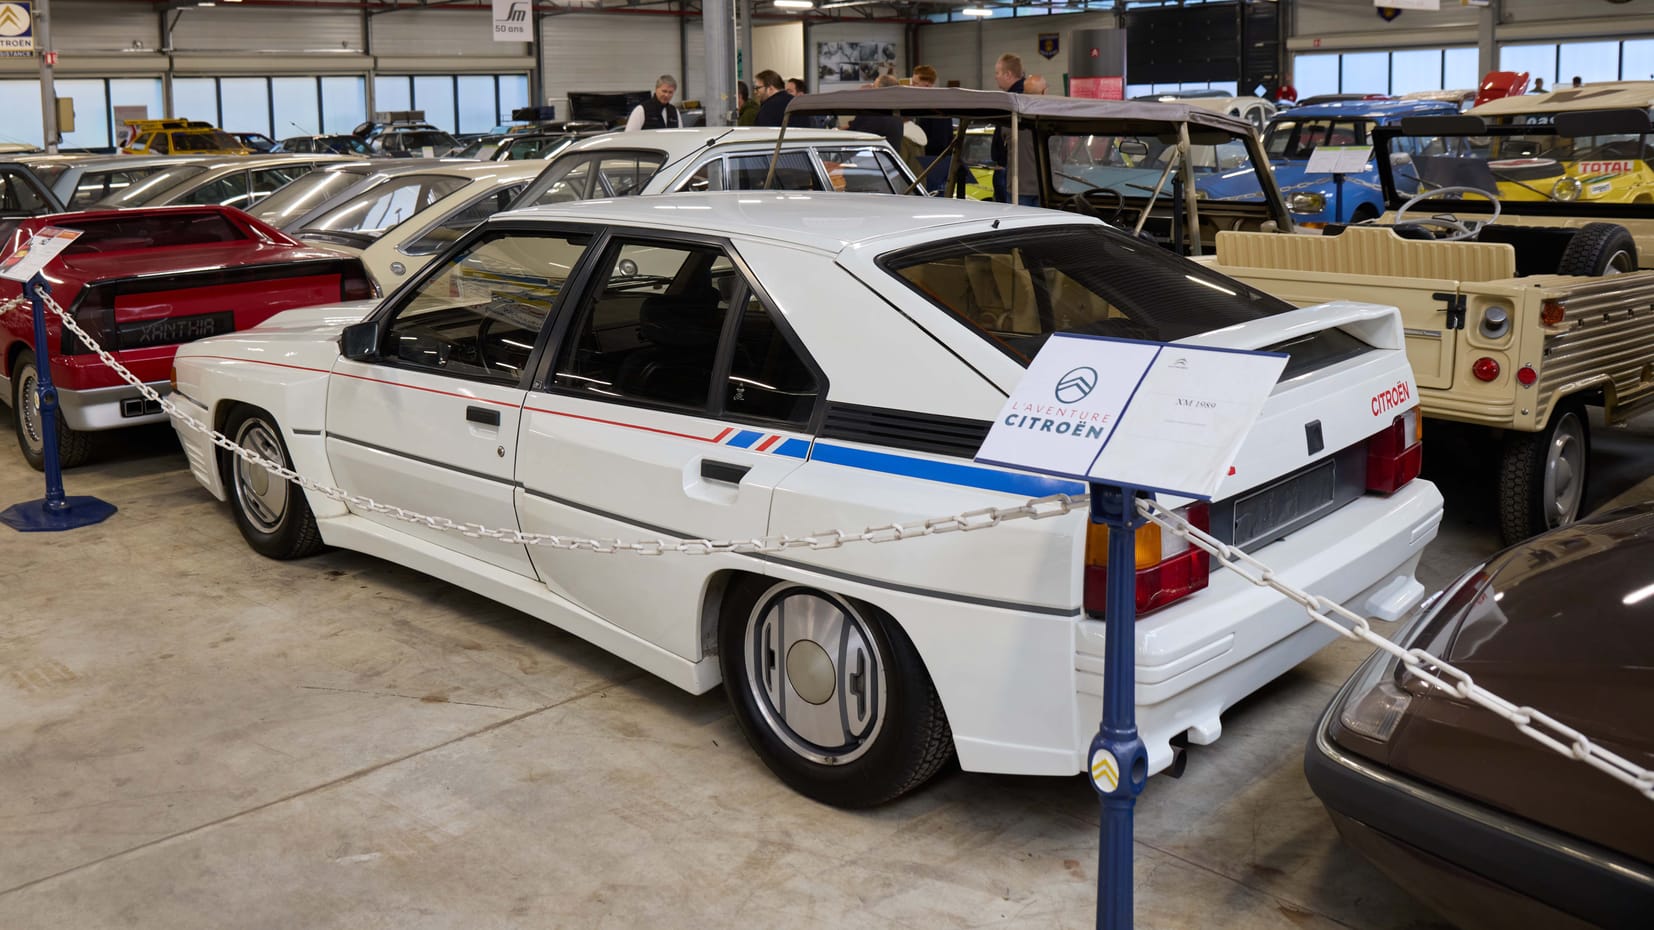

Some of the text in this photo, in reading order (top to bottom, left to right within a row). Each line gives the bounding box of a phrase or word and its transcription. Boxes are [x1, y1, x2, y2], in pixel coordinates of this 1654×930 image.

[495, 25, 506, 33] 50
[1581, 162, 1632, 173] TOTAL
[141, 318, 215, 342] XANTHIA
[1371, 380, 1410, 417] CITROËN
[1012, 402, 1111, 424] L'AVENTURE
[1004, 413, 1104, 439] CITROËN
